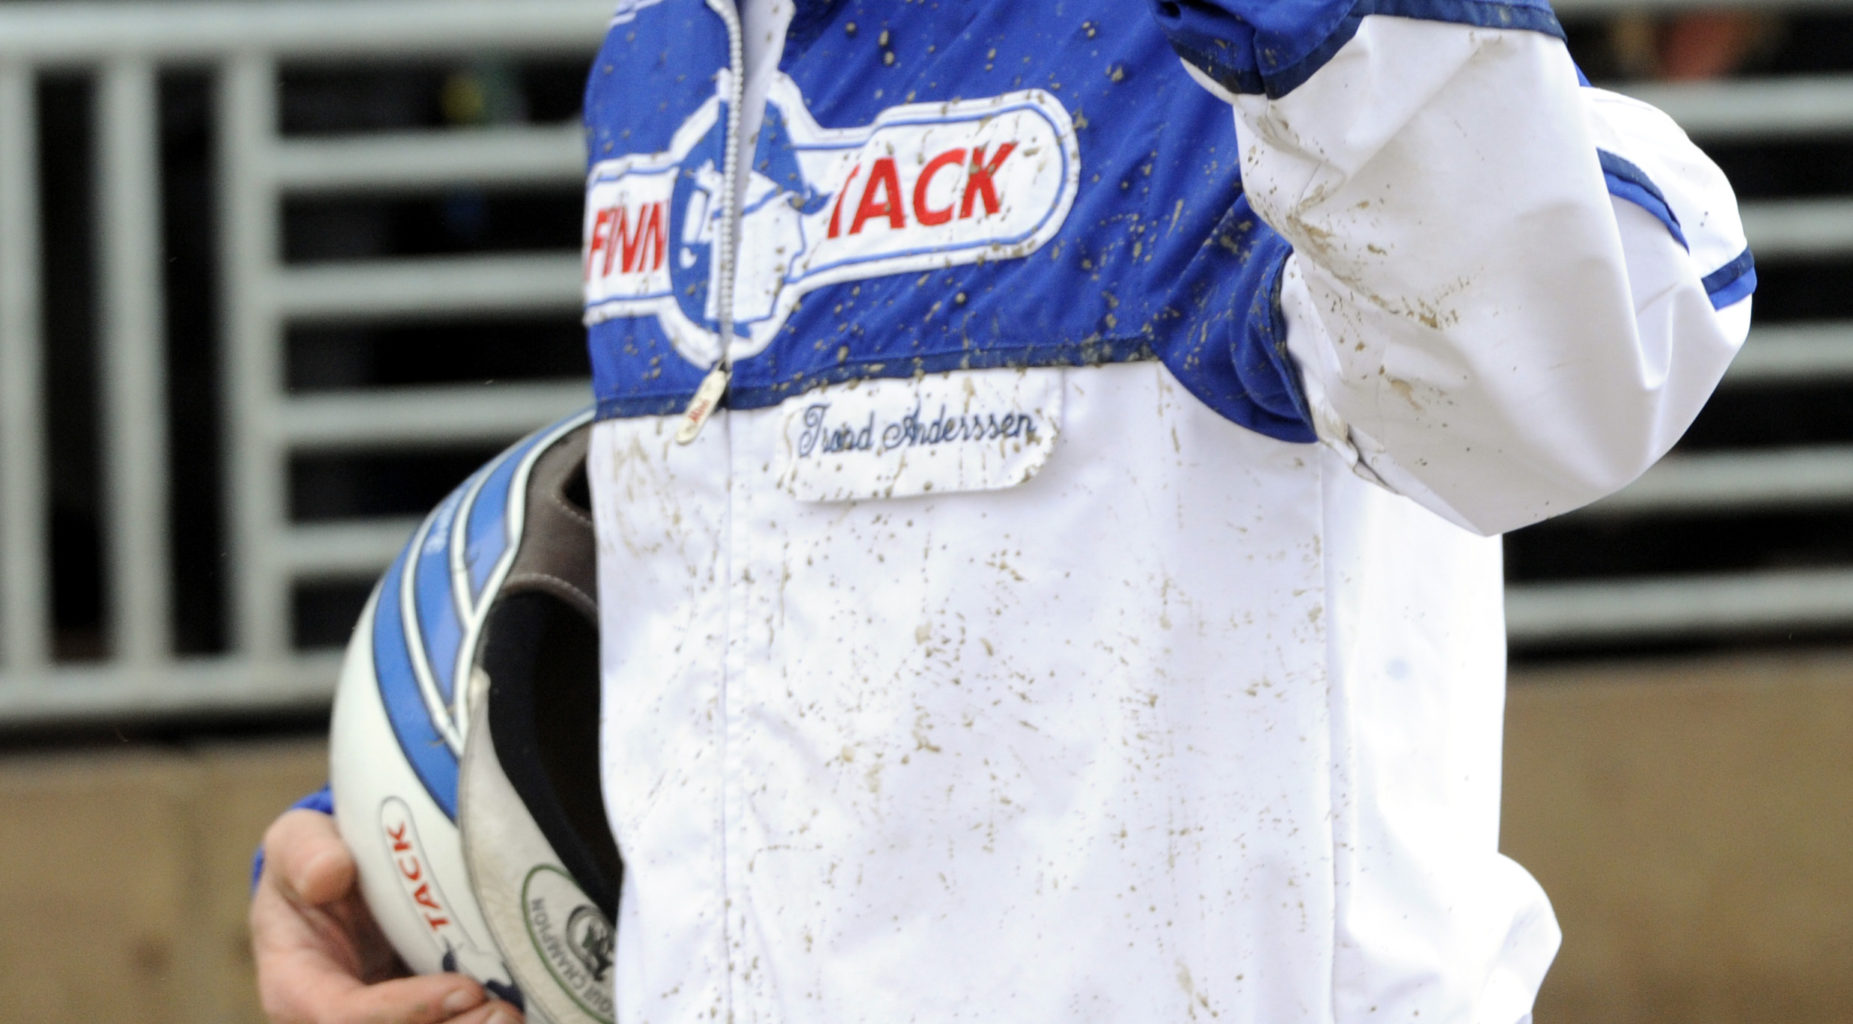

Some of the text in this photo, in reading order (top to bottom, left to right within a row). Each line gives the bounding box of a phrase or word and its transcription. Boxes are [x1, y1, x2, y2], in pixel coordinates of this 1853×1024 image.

[882, 399, 1037, 451] Anderssen
[387, 821, 450, 932] TACK
[531, 897, 586, 990] CHAMPION
